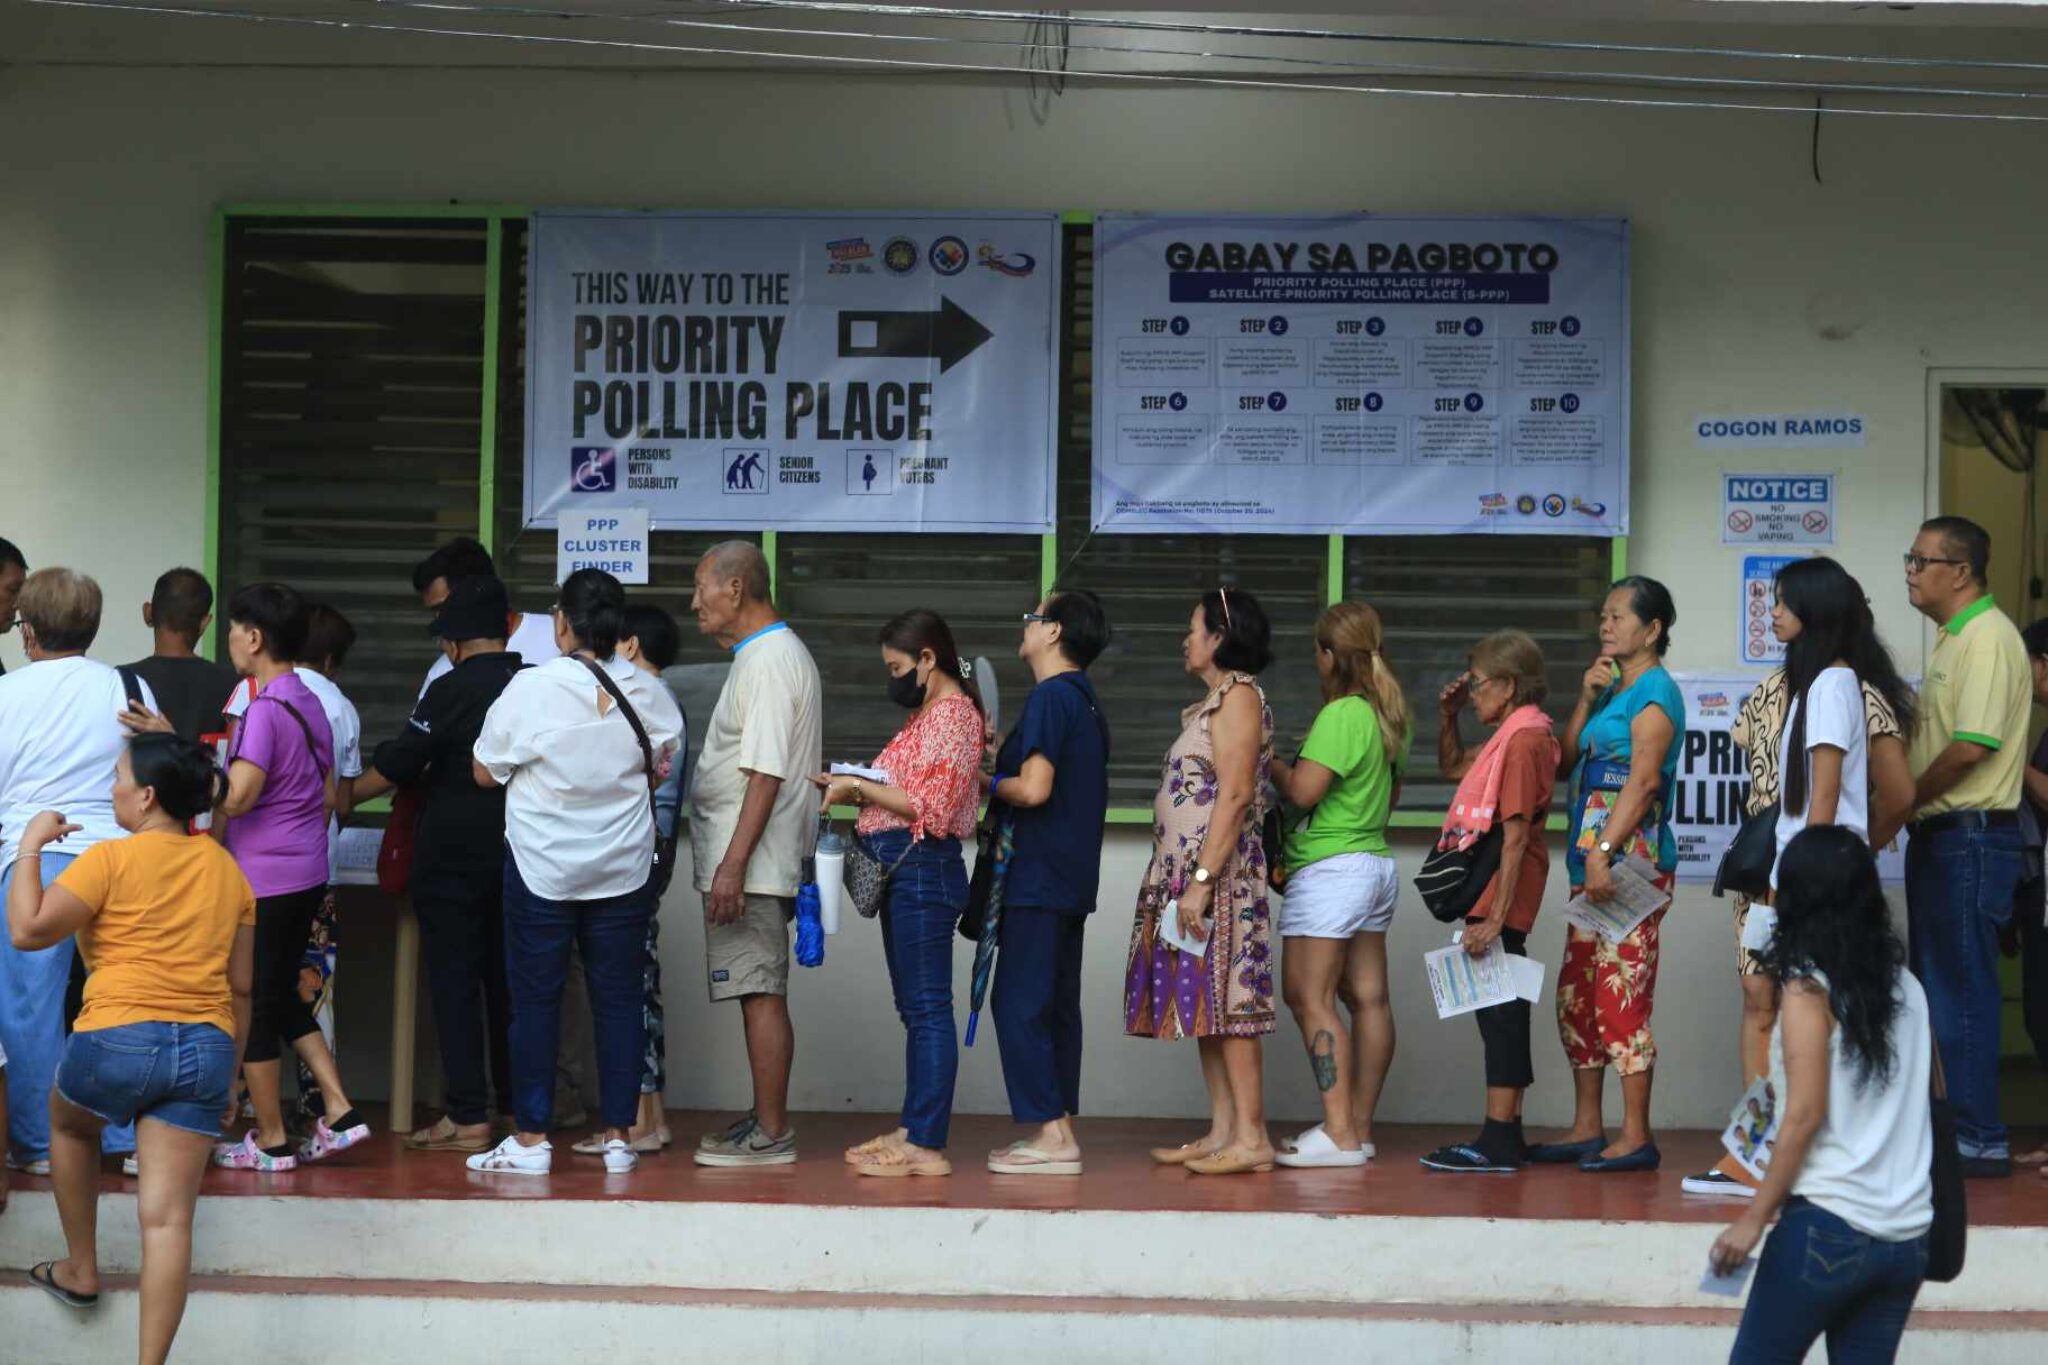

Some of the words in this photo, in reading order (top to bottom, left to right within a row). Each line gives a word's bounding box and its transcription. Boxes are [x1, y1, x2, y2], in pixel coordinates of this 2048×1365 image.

[1165, 242, 1298, 272] GABAY
[1307, 242, 1357, 272] SA
[1367, 243, 1559, 273] PAGBOTO
[573, 272, 628, 304] THIS
[635, 273, 694, 304] WAY
[701, 274, 734, 305] TO
[741, 273, 790, 305] THE
[1254, 277, 1316, 287] PRIORITY
[1321, 277, 1379, 288] POLLING
[1383, 278, 1427, 288] PLACE
[1431, 278, 1465, 289] (PPP)
[1209, 289, 1348, 299] SATELLITE-PRIORITY
[1353, 289, 1411, 299] POLLING
[1415, 290, 1459, 300] PLACE
[1142, 319, 1167, 333] STEP
[1240, 319, 1265, 333] STEP
[1336, 320, 1362, 334] STEP
[1435, 321, 1461, 334] STEP
[1531, 321, 1556, 335] STEP
[573, 314, 786, 374] PRIORITY
[1141, 396, 1166, 410] STEP
[1240, 396, 1264, 410] STEP
[1336, 397, 1361, 411] STEP
[1434, 398, 1460, 411] STEP
[1530, 398, 1556, 412] STEP
[573, 380, 767, 439] POLLING
[785, 382, 932, 440] PLACE
[1698, 421, 1777, 437] COGON
[1784, 418, 1862, 436] RAMOS
[628, 448, 672, 460] PERSONS
[628, 462, 652, 475] WITH
[779, 456, 814, 469] SENIOR
[628, 476, 679, 489] DISABILITY
[779, 471, 821, 483] CITIZENS
[1732, 481, 1825, 499] NOTICE
[1771, 504, 1785, 513] NO
[587, 519, 619, 531] PPP
[1755, 514, 1800, 523] SMOKING
[1769, 523, 1783, 531] NO
[1758, 533, 1794, 541] VAPING
[564, 540, 641, 552] CLUSTER
[572, 561, 633, 573] FINDER
[1684, 730, 1751, 775] PRI
[1675, 780, 1751, 825] LLIN
